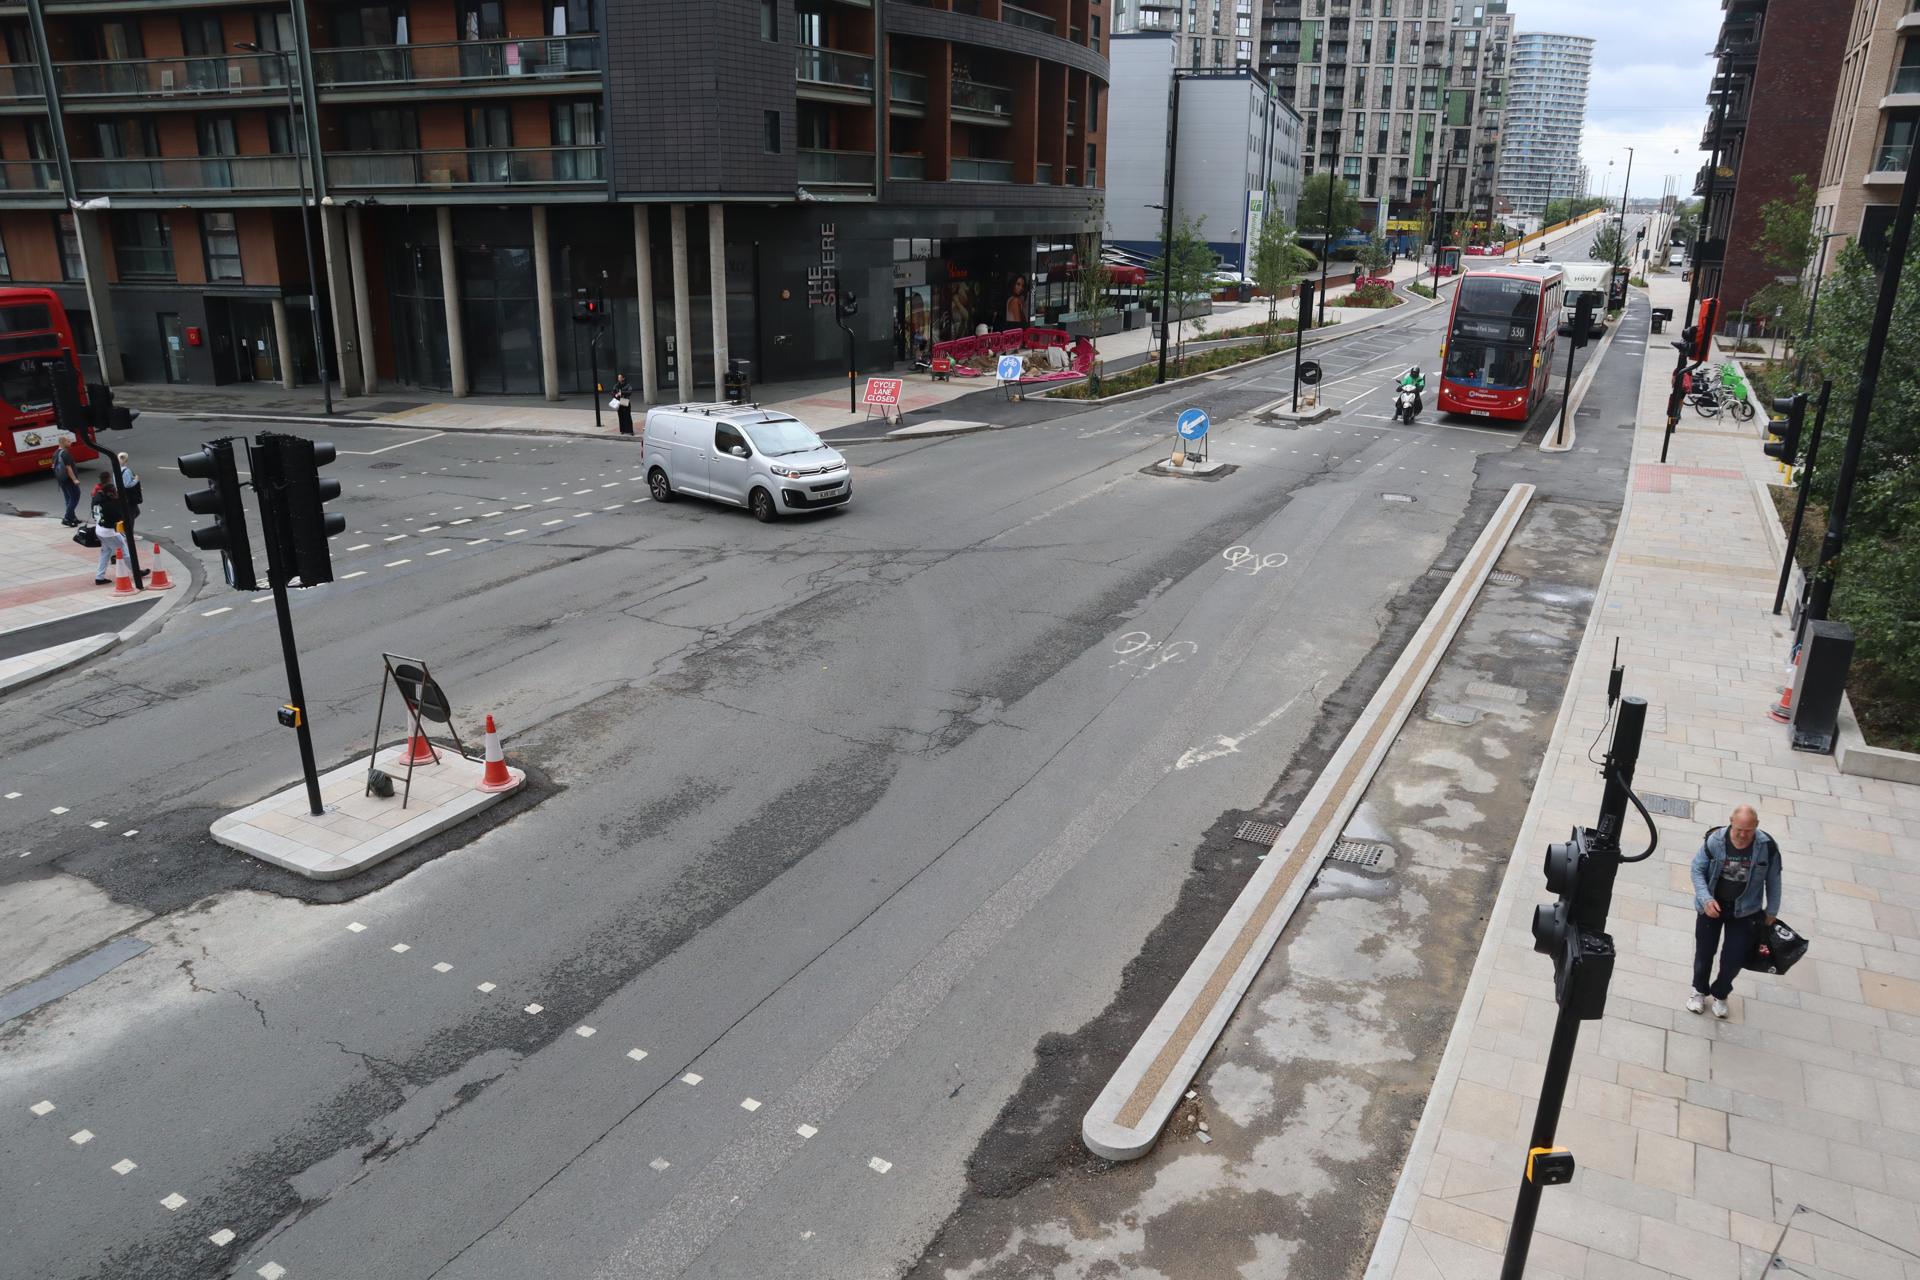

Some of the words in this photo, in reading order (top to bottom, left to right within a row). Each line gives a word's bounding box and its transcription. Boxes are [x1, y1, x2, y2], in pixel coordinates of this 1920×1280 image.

[821, 223, 836, 306] SPHERE
[808, 266, 822, 309] THE
[1511, 326, 1525, 338] 330
[873, 381, 896, 389] CYCLE
[867, 394, 896, 402] CLOSED
